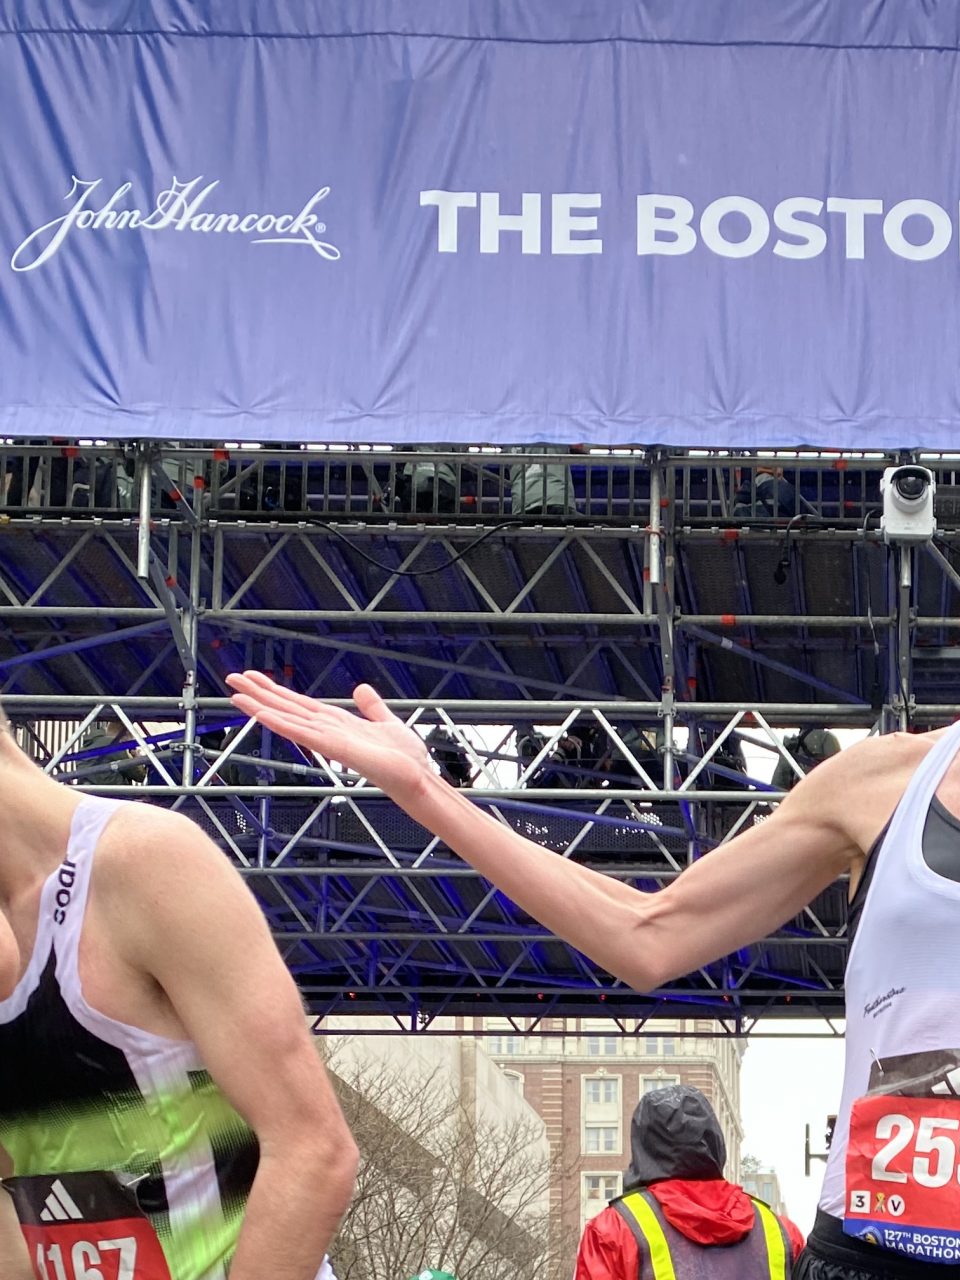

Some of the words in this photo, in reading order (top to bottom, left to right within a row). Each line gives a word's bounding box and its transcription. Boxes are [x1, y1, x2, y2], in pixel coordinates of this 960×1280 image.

[11, 175, 141, 271] John
[420, 189, 603, 255] THE
[855, 1195, 865, 1208] 3
[891, 1200, 902, 1212] V
